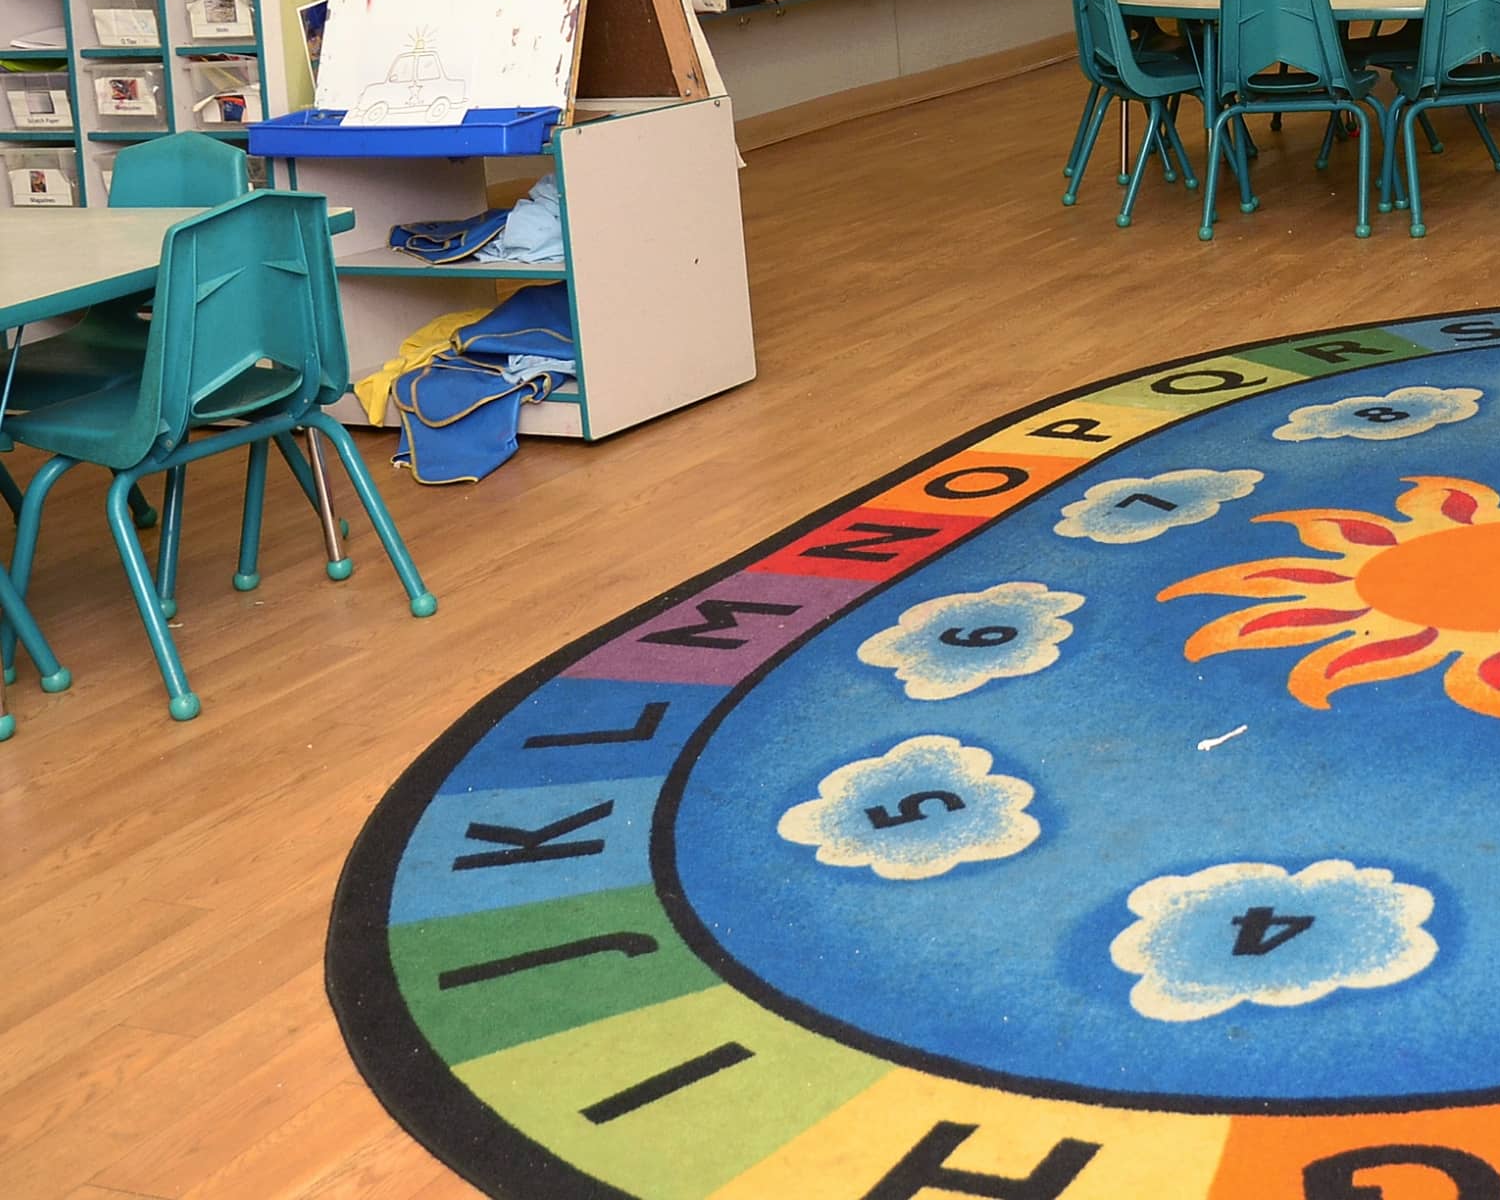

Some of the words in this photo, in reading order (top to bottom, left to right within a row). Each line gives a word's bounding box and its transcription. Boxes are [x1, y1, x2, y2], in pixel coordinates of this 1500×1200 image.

[1294, 340, 1393, 364] R
[1150, 369, 1268, 396] Q
[1030, 418, 1113, 444] P
[1357, 406, 1412, 424] 8
[923, 465, 1031, 500] O
[1114, 493, 1179, 511] 7
[796, 522, 935, 562] N
[637, 599, 803, 649] M
[939, 623, 1020, 649] 6
[523, 702, 670, 749] L
[864, 788, 966, 831] 5
[452, 799, 614, 872] K
[1231, 906, 1316, 956] 4
[438, 931, 659, 990] J
[577, 1041, 756, 1125] I
